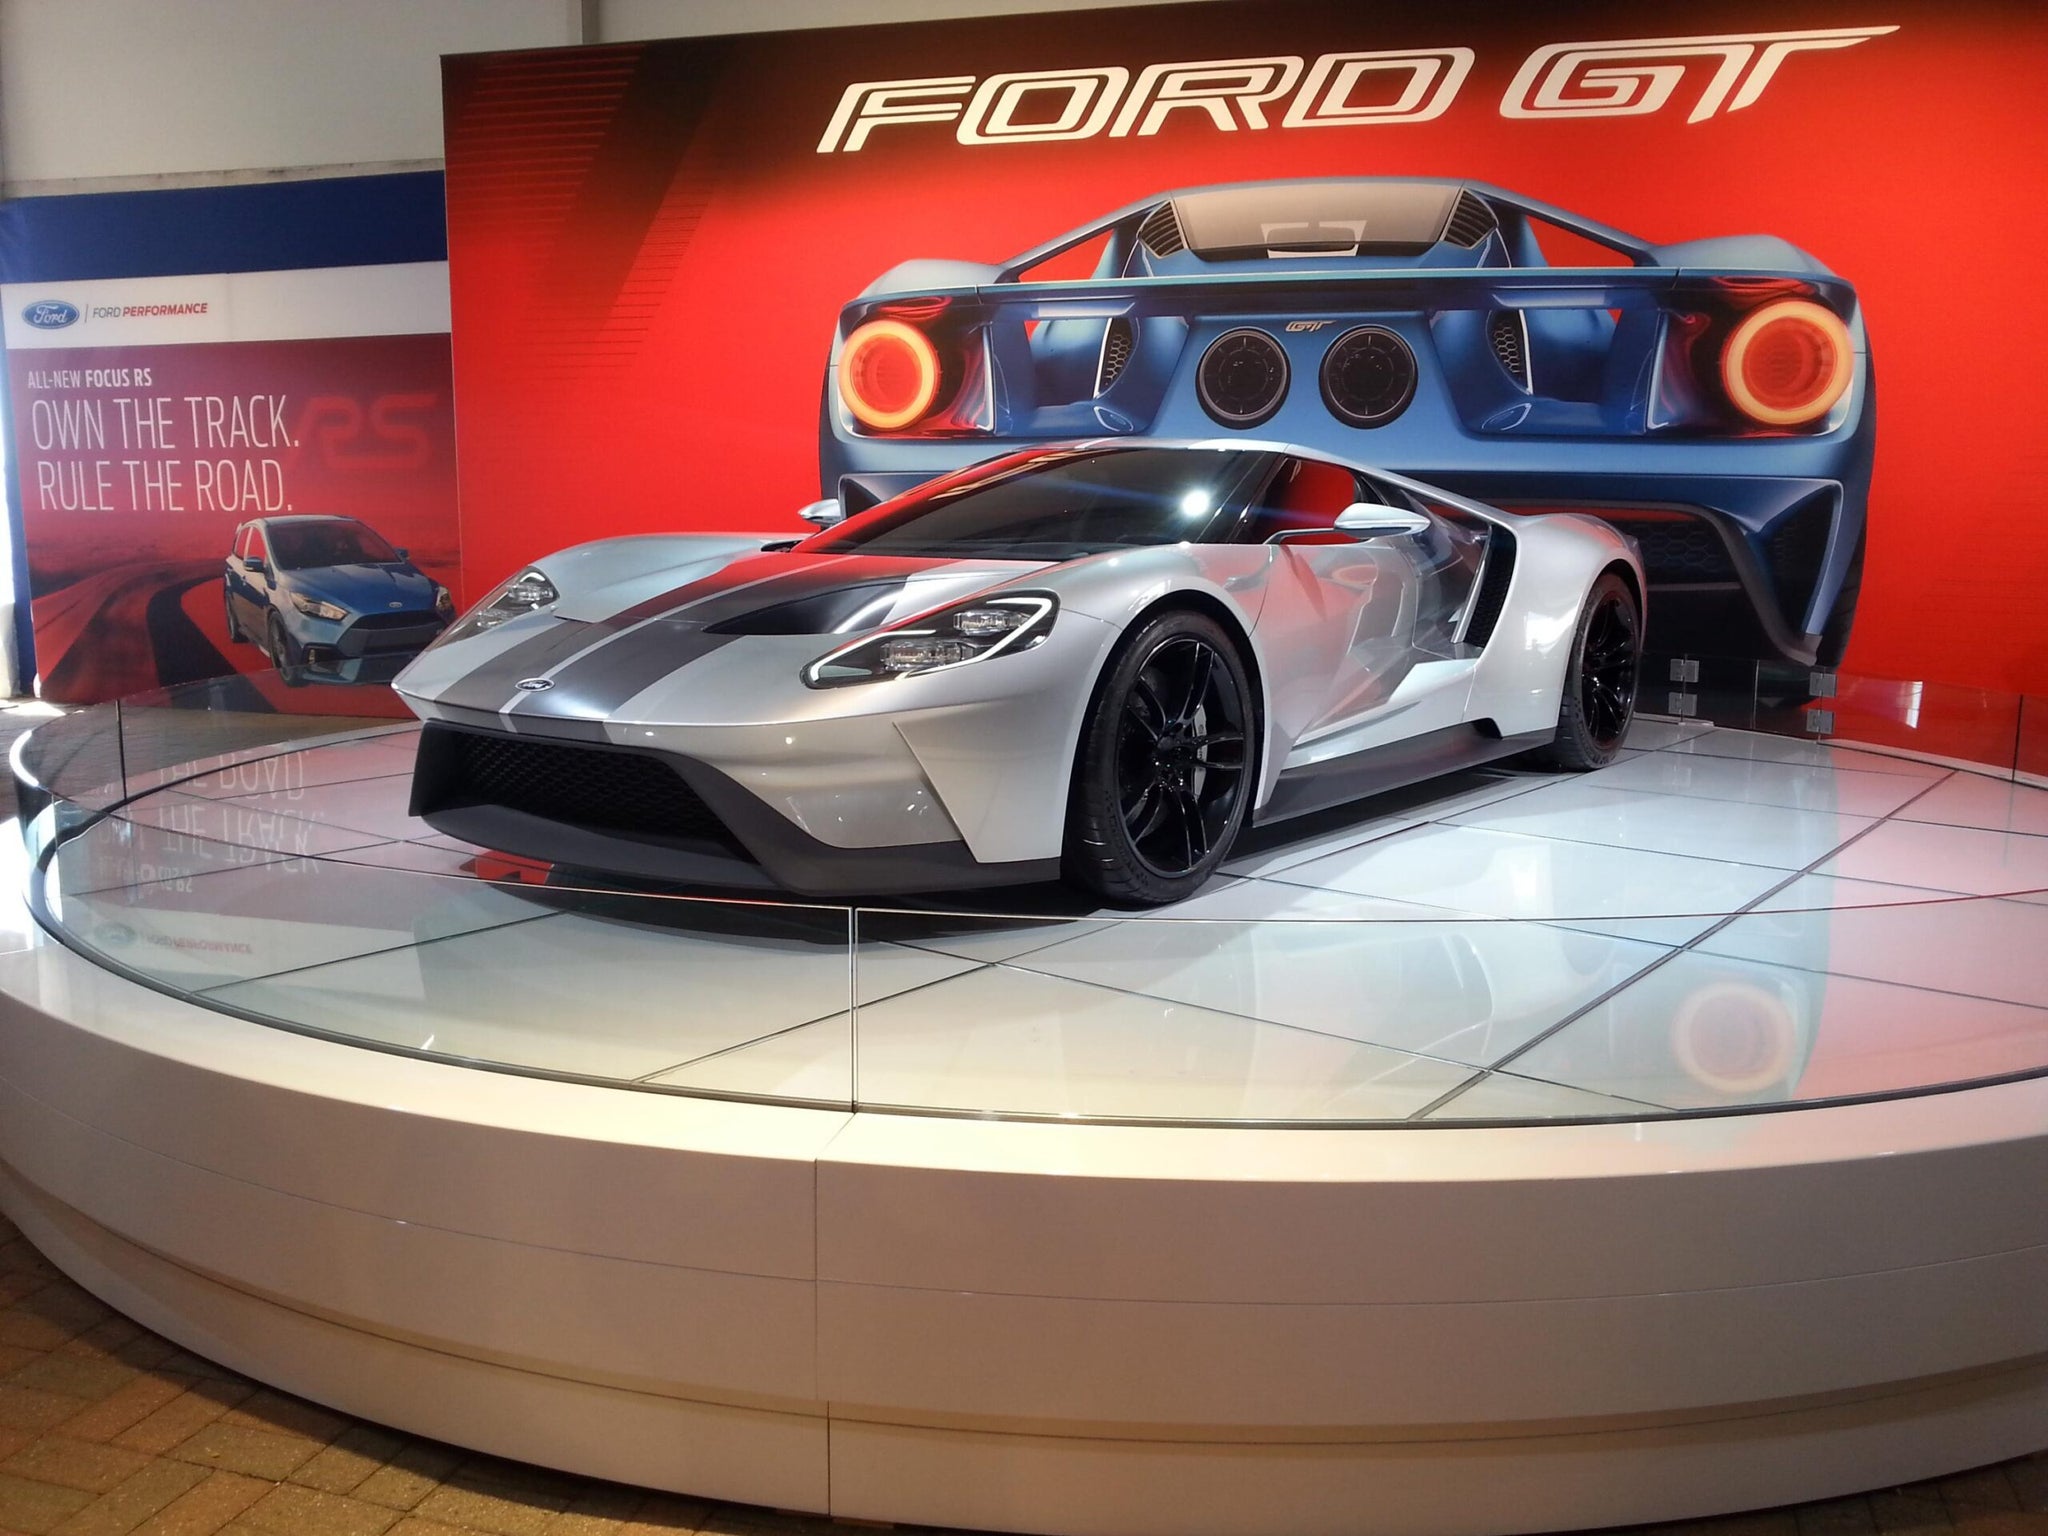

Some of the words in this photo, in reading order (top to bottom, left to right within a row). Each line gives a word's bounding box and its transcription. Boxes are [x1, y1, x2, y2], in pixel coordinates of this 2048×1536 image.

[816, 46, 1476, 154] FORD
[1499, 25, 1902, 124] GT
[33, 304, 68, 325] Ford
[93, 307, 121, 318] FORD
[122, 303, 208, 317] PERFORMANCE
[28, 370, 81, 389] ALL-NEW
[85, 368, 130, 388] FOCUS
[134, 368, 153, 387] RS
[32, 400, 105, 449] OWN
[114, 398, 176, 449] THE
[184, 395, 300, 448] TRACK.
[38, 460, 114, 510] RULE
[122, 460, 184, 511] THE
[194, 459, 293, 511] ROAD.
